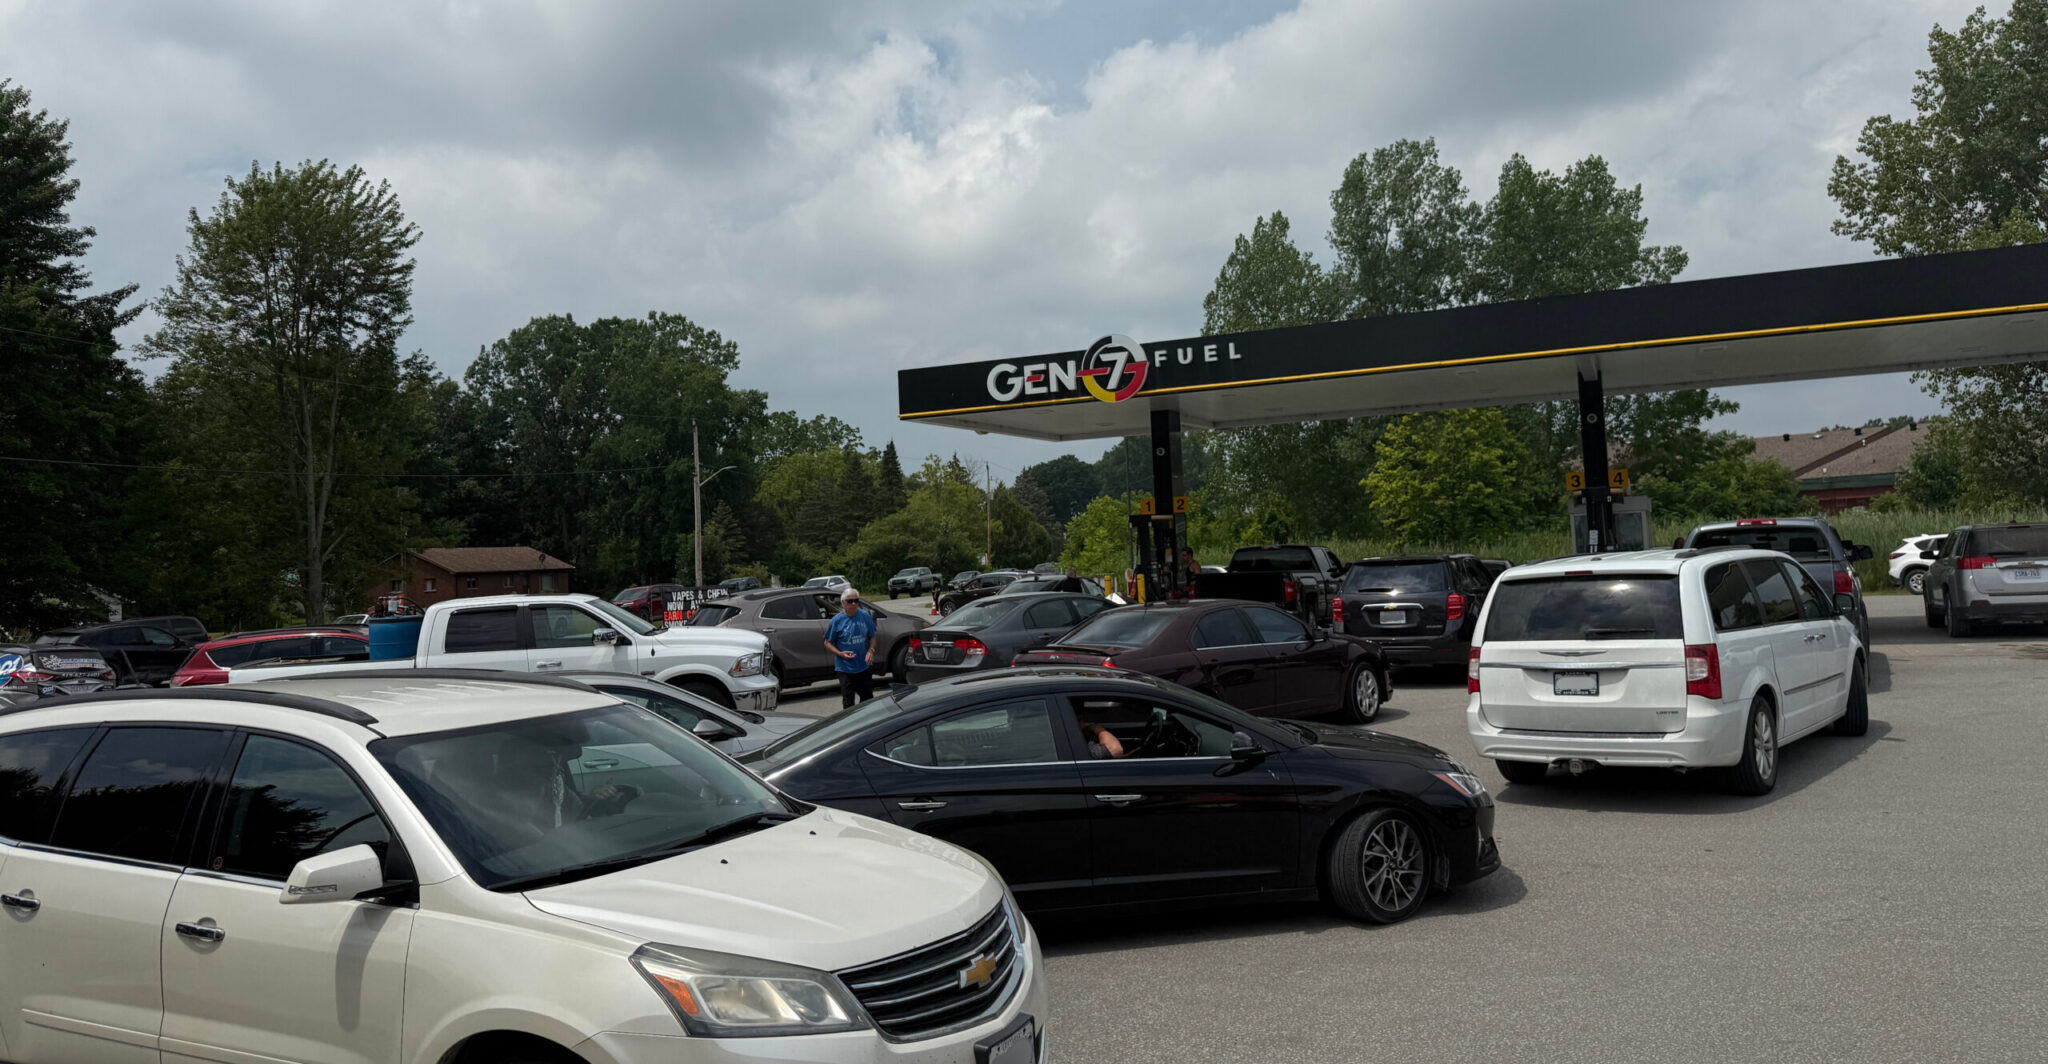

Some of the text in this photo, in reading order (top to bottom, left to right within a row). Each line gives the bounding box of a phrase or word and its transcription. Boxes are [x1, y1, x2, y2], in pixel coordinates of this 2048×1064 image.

[1154, 342, 1242, 368] FUEL
[986, 360, 1076, 401] GEN
[1571, 475, 1581, 487] 3
[1613, 471, 1624, 485] 4
[1177, 499, 1184, 510] 2
[671, 590, 695, 602] VAPES
[697, 590, 704, 600] &
[667, 601, 684, 611] NOW
[663, 611, 683, 622] EARN
